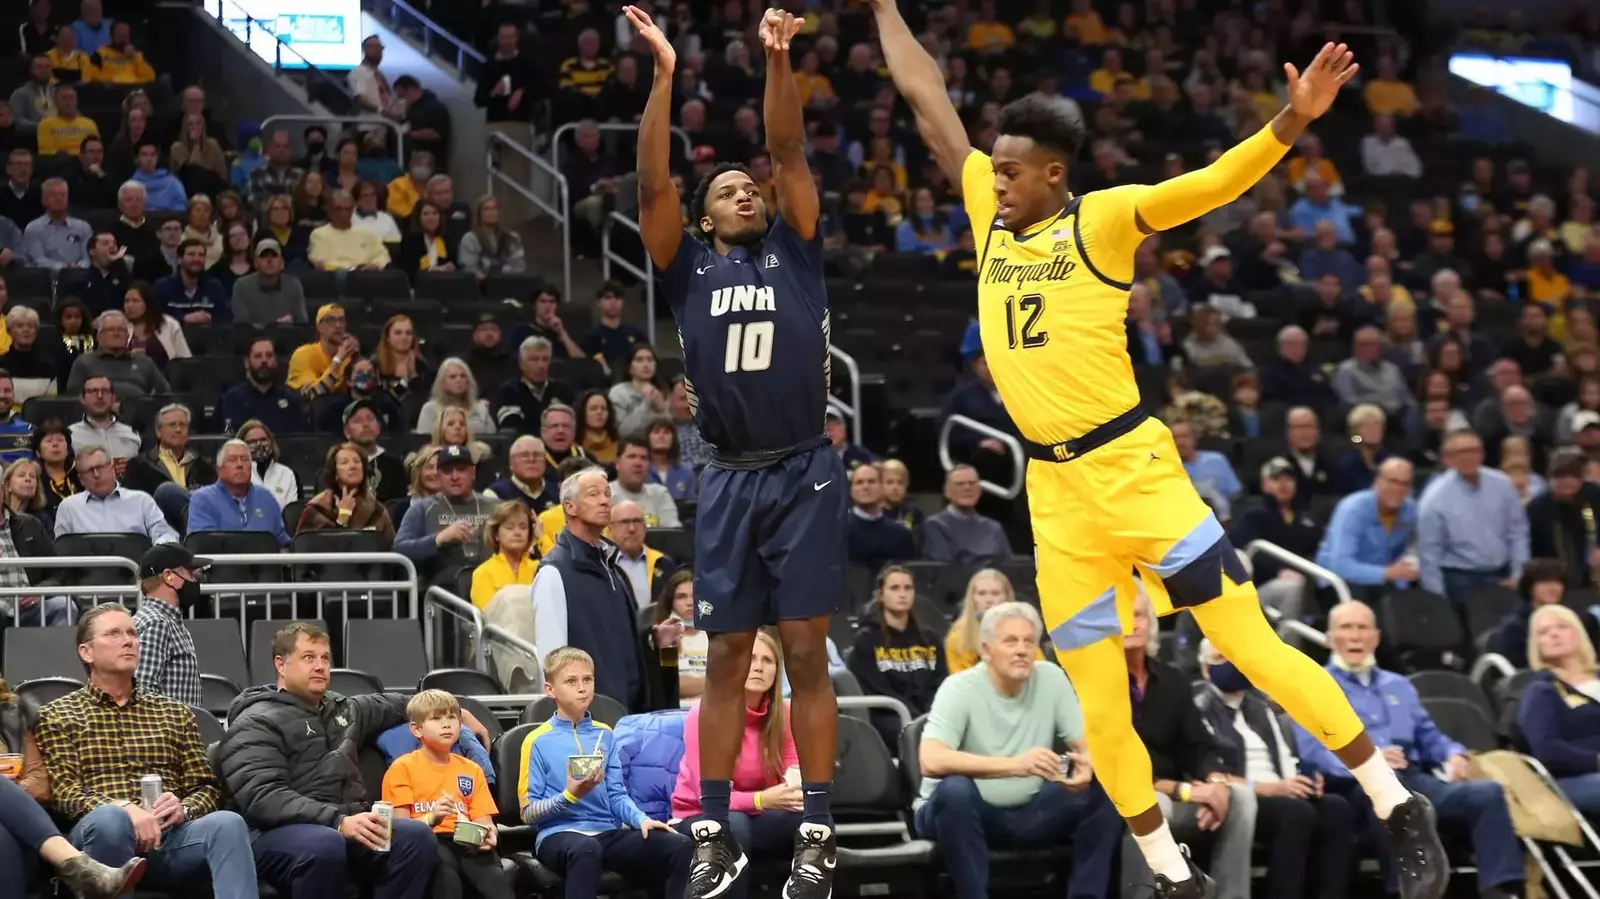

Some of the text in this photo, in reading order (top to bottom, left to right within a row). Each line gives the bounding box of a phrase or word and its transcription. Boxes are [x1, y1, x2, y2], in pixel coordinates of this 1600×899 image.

[984, 255, 1077, 290] Marquette
[710, 285, 776, 316] UNH
[1005, 293, 1049, 349] 12
[724, 321, 774, 373] 10
[460, 779, 472, 790] EB
